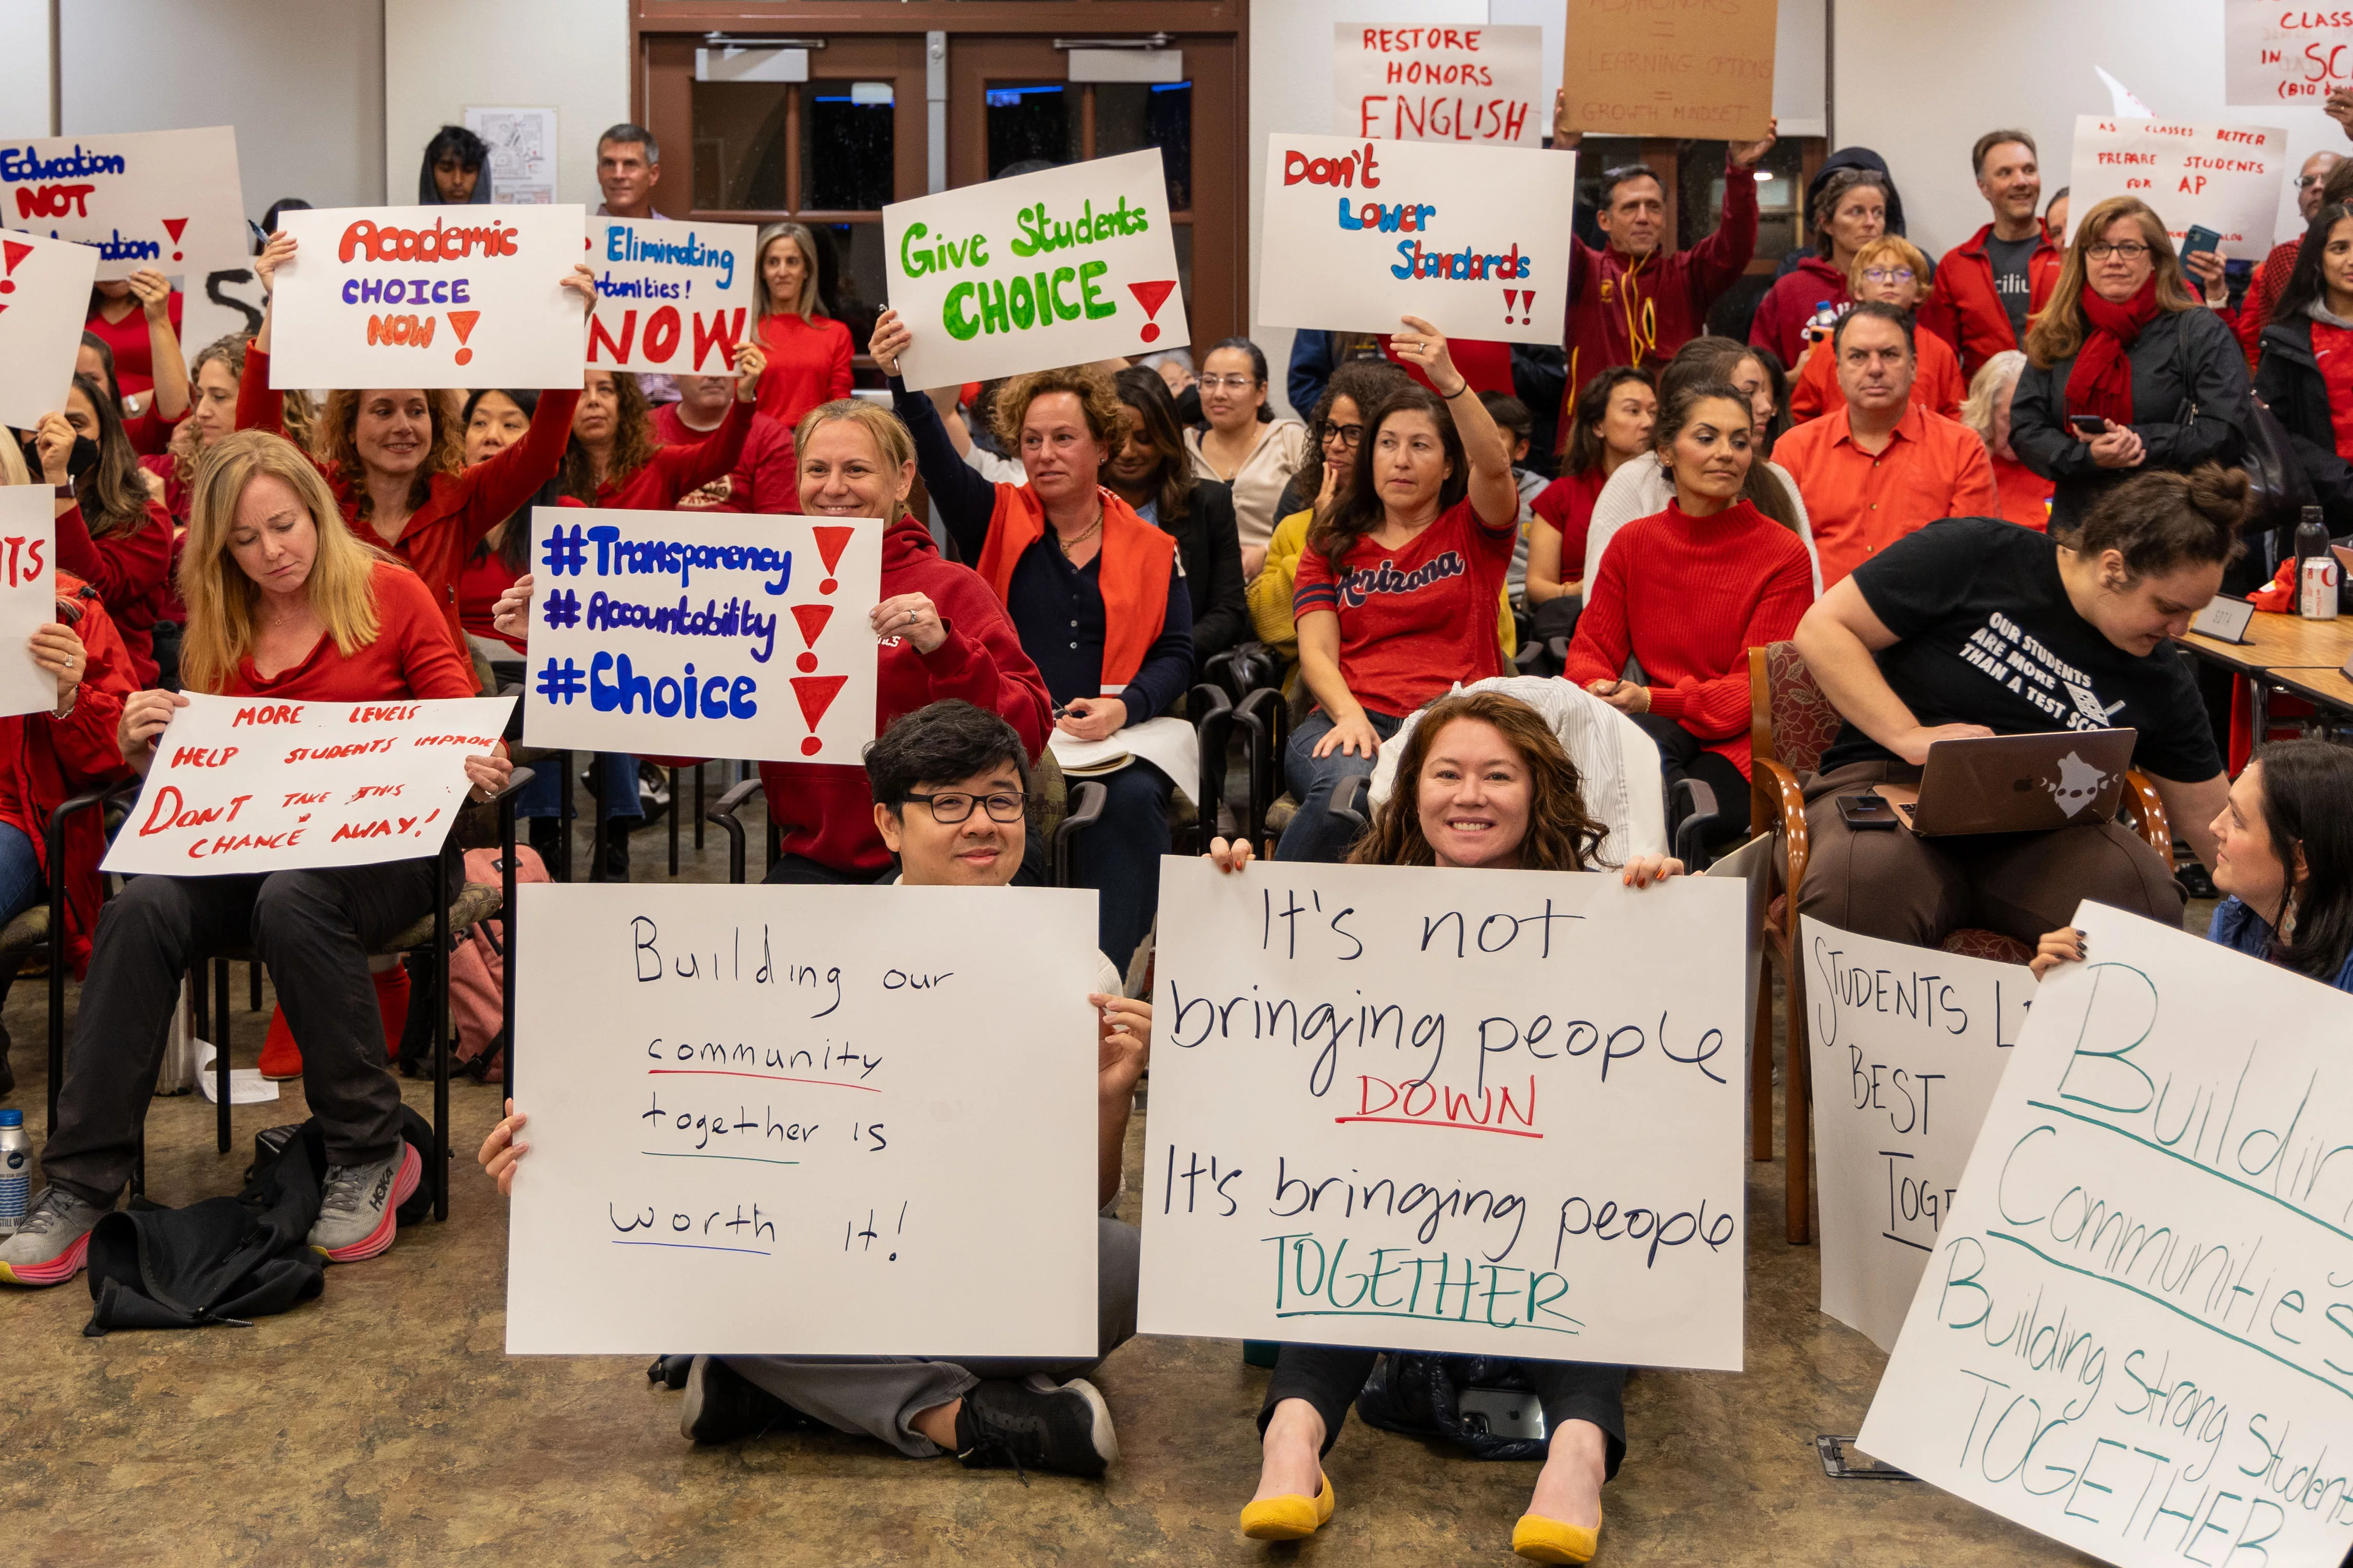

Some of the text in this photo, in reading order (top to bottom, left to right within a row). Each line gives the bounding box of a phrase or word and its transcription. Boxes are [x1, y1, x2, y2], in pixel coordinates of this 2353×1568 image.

[1363, 28, 1481, 52] RESTORE
[2262, 42, 2353, 82] IN SC
[1387, 61, 1492, 86] HONORS
[1361, 94, 1528, 141] ENGLISH
[2145, 125, 2193, 137] CLASSES
[2217, 129, 2266, 145] BETTER
[0, 144, 125, 182] Education
[1284, 143, 1380, 188] Don't
[2097, 152, 2264, 174] PREPARE STUDENTS
[2127, 176, 2207, 195] FOR AP
[16, 184, 95, 219] NOT
[1338, 197, 1436, 233] Lower
[339, 216, 518, 263] Academic
[607, 226, 734, 289] Eliminating
[901, 196, 1148, 278] Give Students
[1391, 239, 1530, 280] Standards
[342, 279, 470, 304] CHOICE
[587, 305, 747, 372] NOW
[542, 524, 792, 595] #Transparency
[1335, 550, 1465, 608] Arizona
[1969, 627, 2057, 690] ARE MORE
[1989, 612, 2092, 688] OUR STUDENTS
[536, 651, 757, 719] #Choice
[1958, 643, 2009, 681] THAN
[2006, 676, 2022, 694] A
[2026, 686, 2066, 719] TEST
[232, 705, 422, 728] MORE LEVELS
[171, 735, 497, 768] HELP STUDENTS IMPROVE
[282, 791, 332, 808] TAKE
[348, 784, 406, 802] THIS
[188, 808, 440, 858] CHANCE AWAY!
[1263, 888, 1586, 960] It's not
[630, 915, 954, 1018] Building our
[1815, 936, 1967, 1047] STUDENTS
[647, 1037, 883, 1079] community
[1170, 979, 1727, 1099] bringing people
[1356, 1074, 1536, 1127] DOWN
[1848, 1043, 1946, 1135] BEST
[2057, 962, 2353, 1224] Buildin
[641, 1091, 887, 1152] together is
[369, 1166, 394, 1212] HOKA
[1163, 1144, 1734, 1269] It's bringing people
[609, 1201, 775, 1242] worth
[1260, 1232, 1586, 1328] TOGETHER
[1938, 1236, 2106, 1420] Building
[2115, 1349, 2228, 1482] Strong
[1959, 1369, 2284, 1568] TOGETHER
